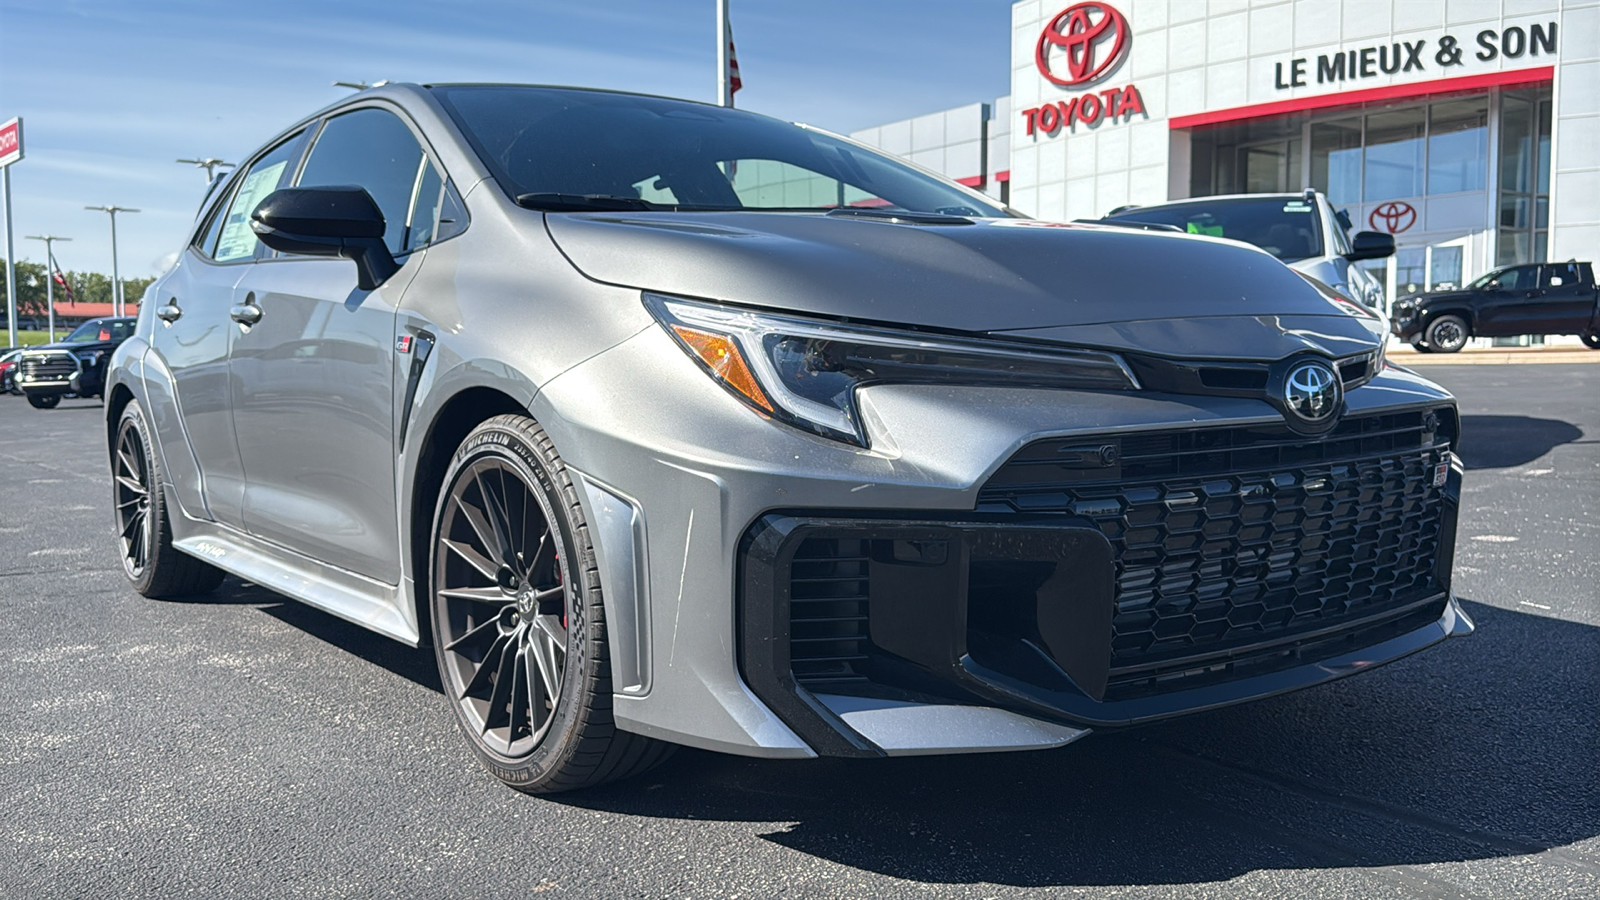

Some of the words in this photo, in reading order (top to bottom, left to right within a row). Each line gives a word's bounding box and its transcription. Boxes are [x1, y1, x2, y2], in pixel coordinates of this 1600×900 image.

[1274, 57, 1307, 90] LE
[1316, 39, 1427, 85] MIEUX
[1434, 34, 1464, 67] &
[1475, 22, 1558, 63] SON
[1021, 84, 1145, 137] TOYOTA
[0, 129, 18, 152] OYOTA
[466, 432, 511, 452] MICHELIN
